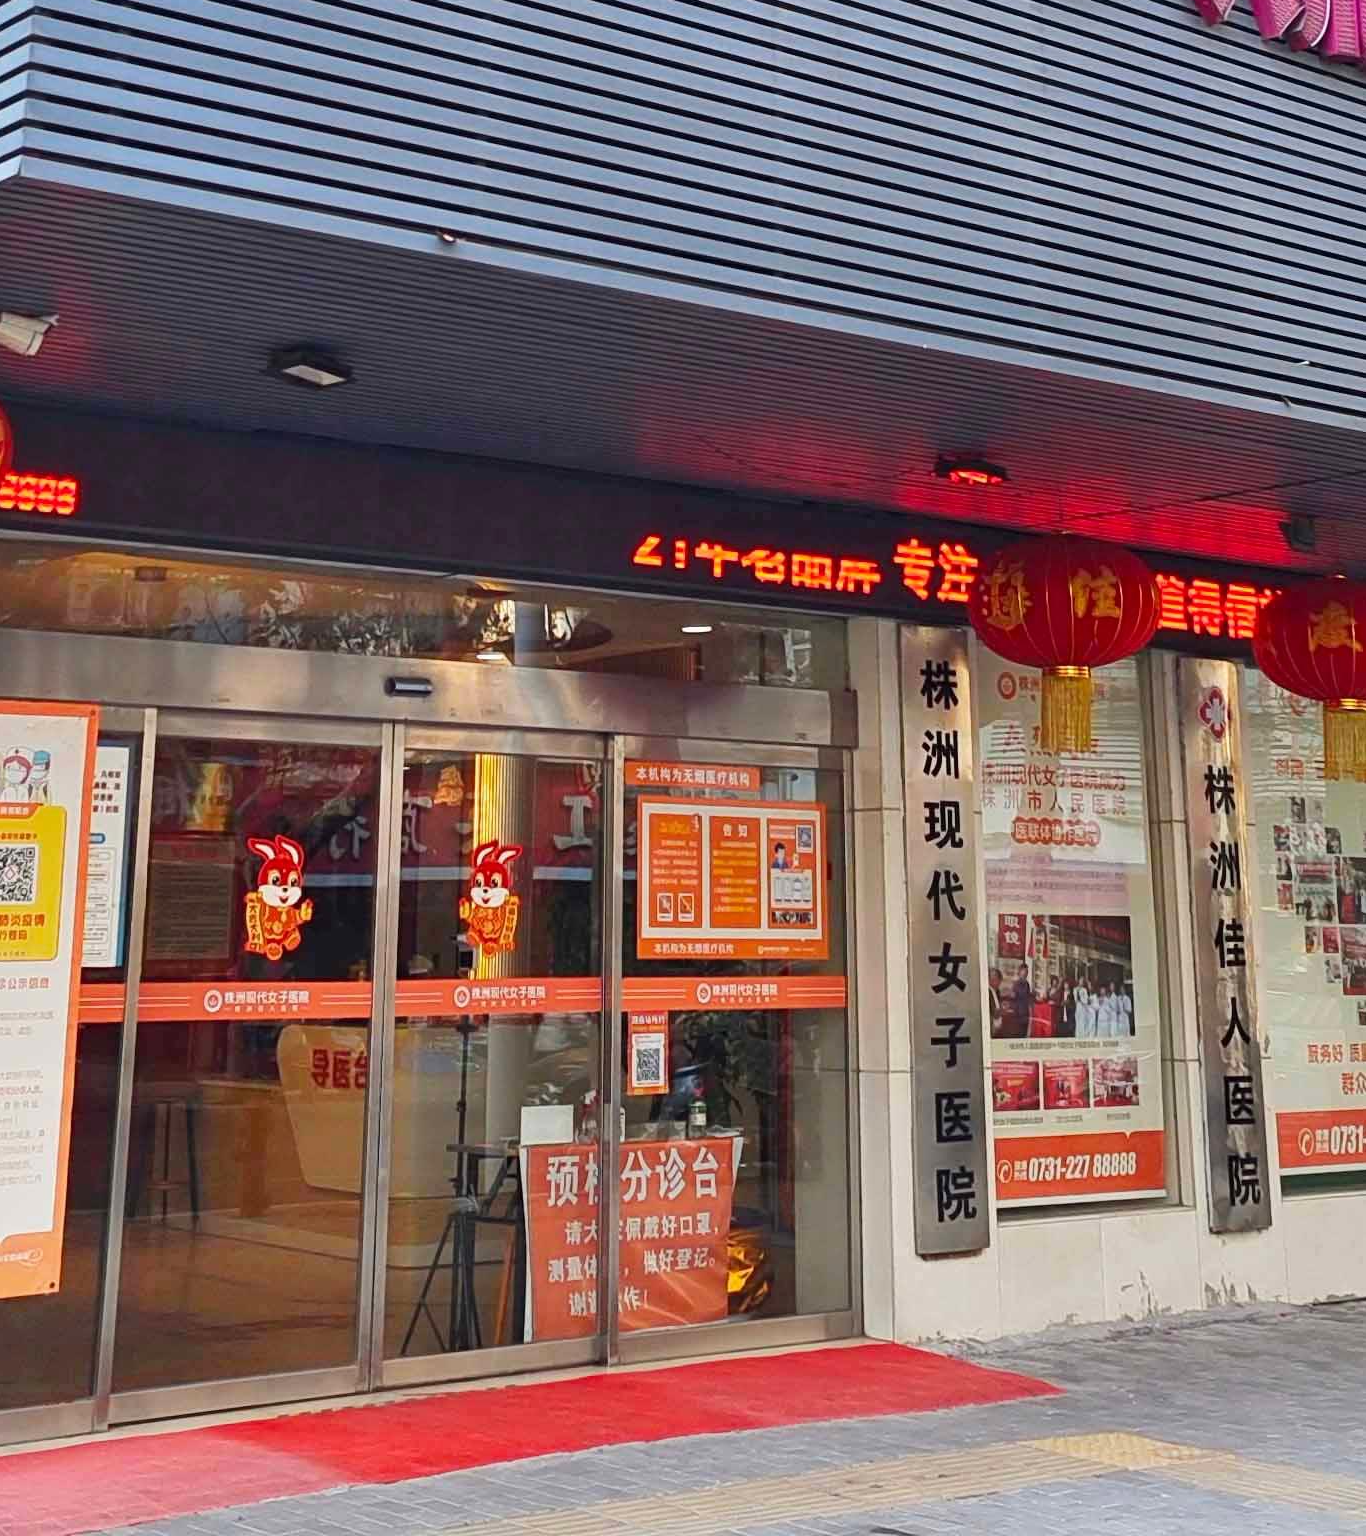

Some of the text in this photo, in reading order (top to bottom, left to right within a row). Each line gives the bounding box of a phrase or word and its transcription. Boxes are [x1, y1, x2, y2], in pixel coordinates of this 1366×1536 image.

[636, 767, 750, 787] 本机构为无烟医疗机构
[919, 660, 977, 1224] 株洲现代女子医院
[1204, 765, 1262, 1207] 株洲佳人医院
